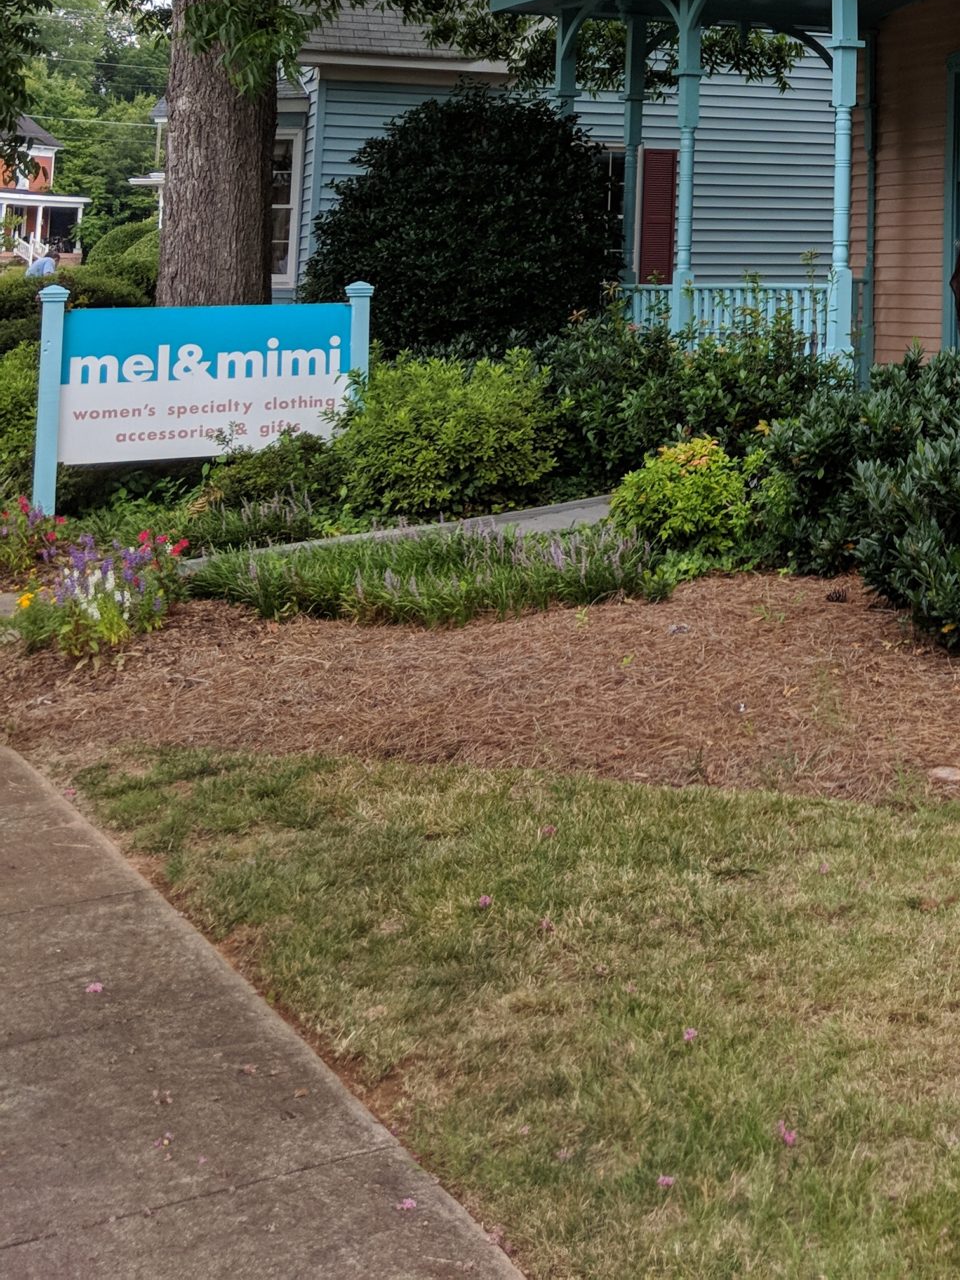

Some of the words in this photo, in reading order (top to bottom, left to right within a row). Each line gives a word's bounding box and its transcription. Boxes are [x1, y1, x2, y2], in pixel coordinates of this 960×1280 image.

[69, 335, 341, 384] mel&mimi
[73, 403, 156, 420] women's
[167, 399, 252, 419] specialty
[264, 395, 335, 414] clothing
[235, 422, 248, 436] &
[260, 419, 301, 437] gifts
